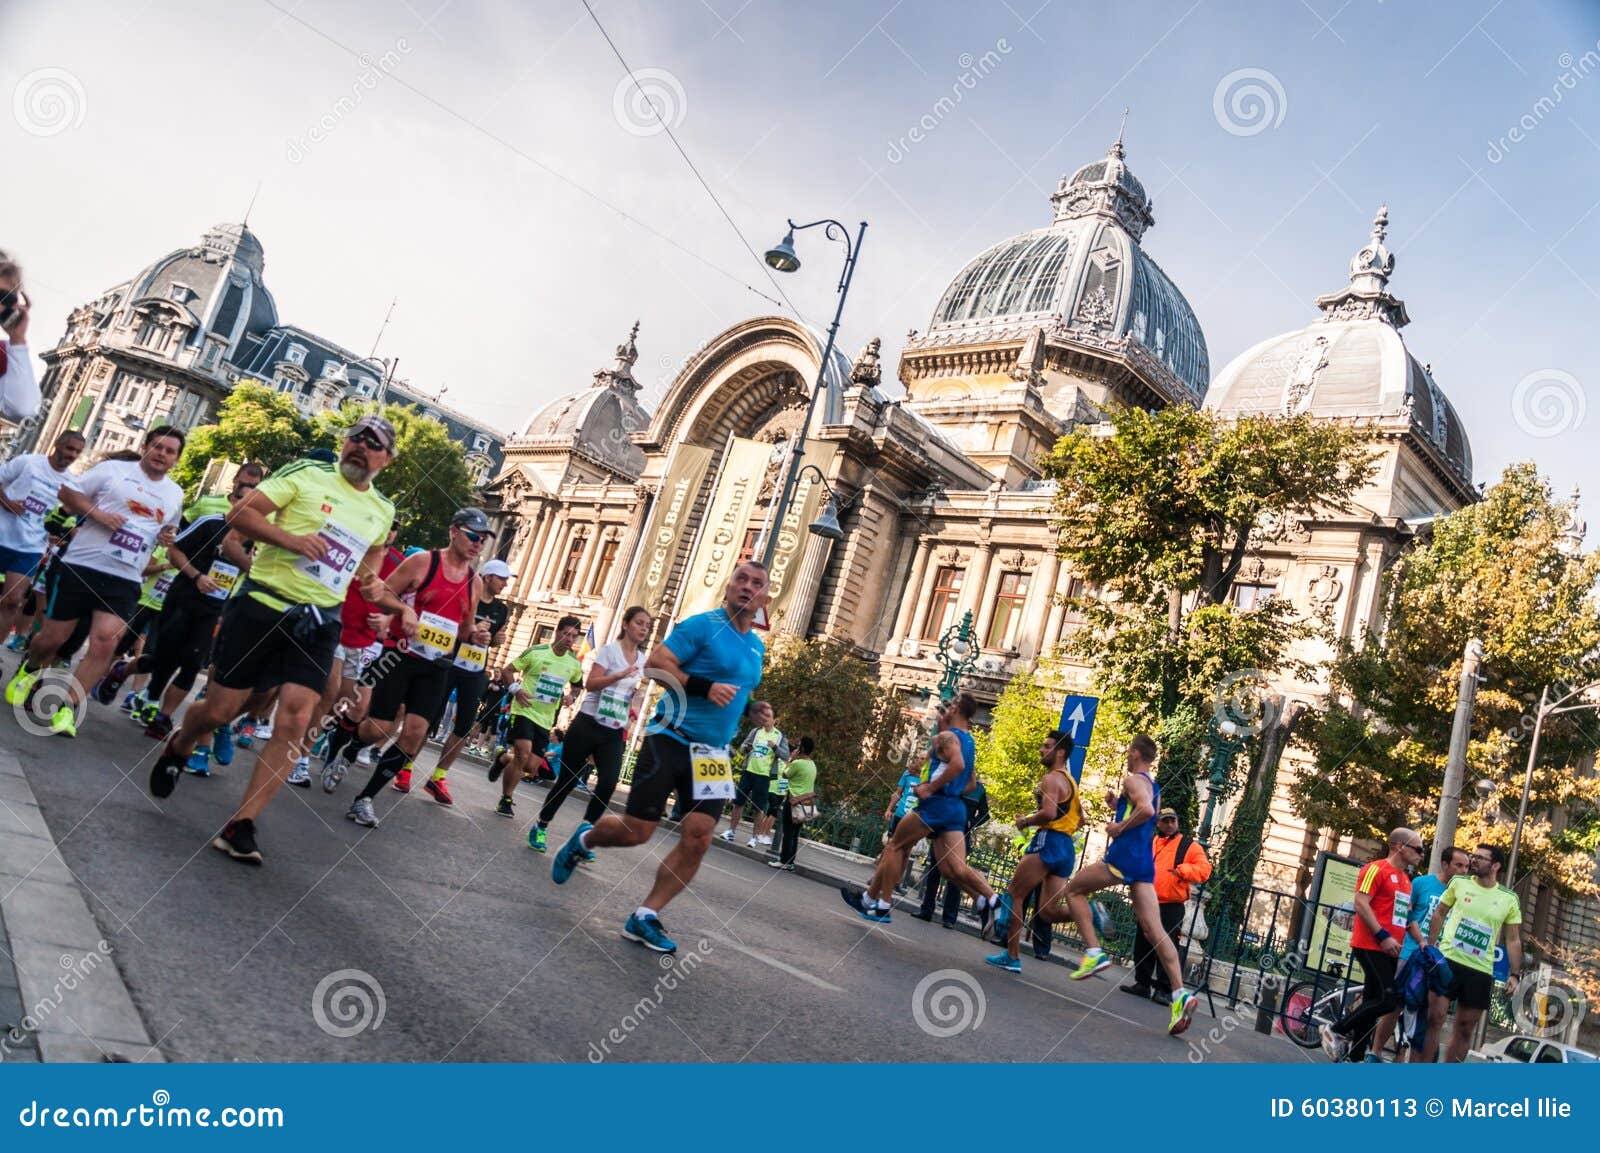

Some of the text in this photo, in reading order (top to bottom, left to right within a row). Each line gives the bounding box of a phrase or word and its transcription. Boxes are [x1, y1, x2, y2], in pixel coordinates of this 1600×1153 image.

[113, 532, 140, 549] 7195
[647, 479, 690, 587] CEC Bank
[704, 477, 749, 587] CEC Bank
[768, 478, 812, 599] CEC Bank
[421, 629, 451, 648] 3133
[467, 650, 482, 662] 193
[700, 763, 726, 776] 308
